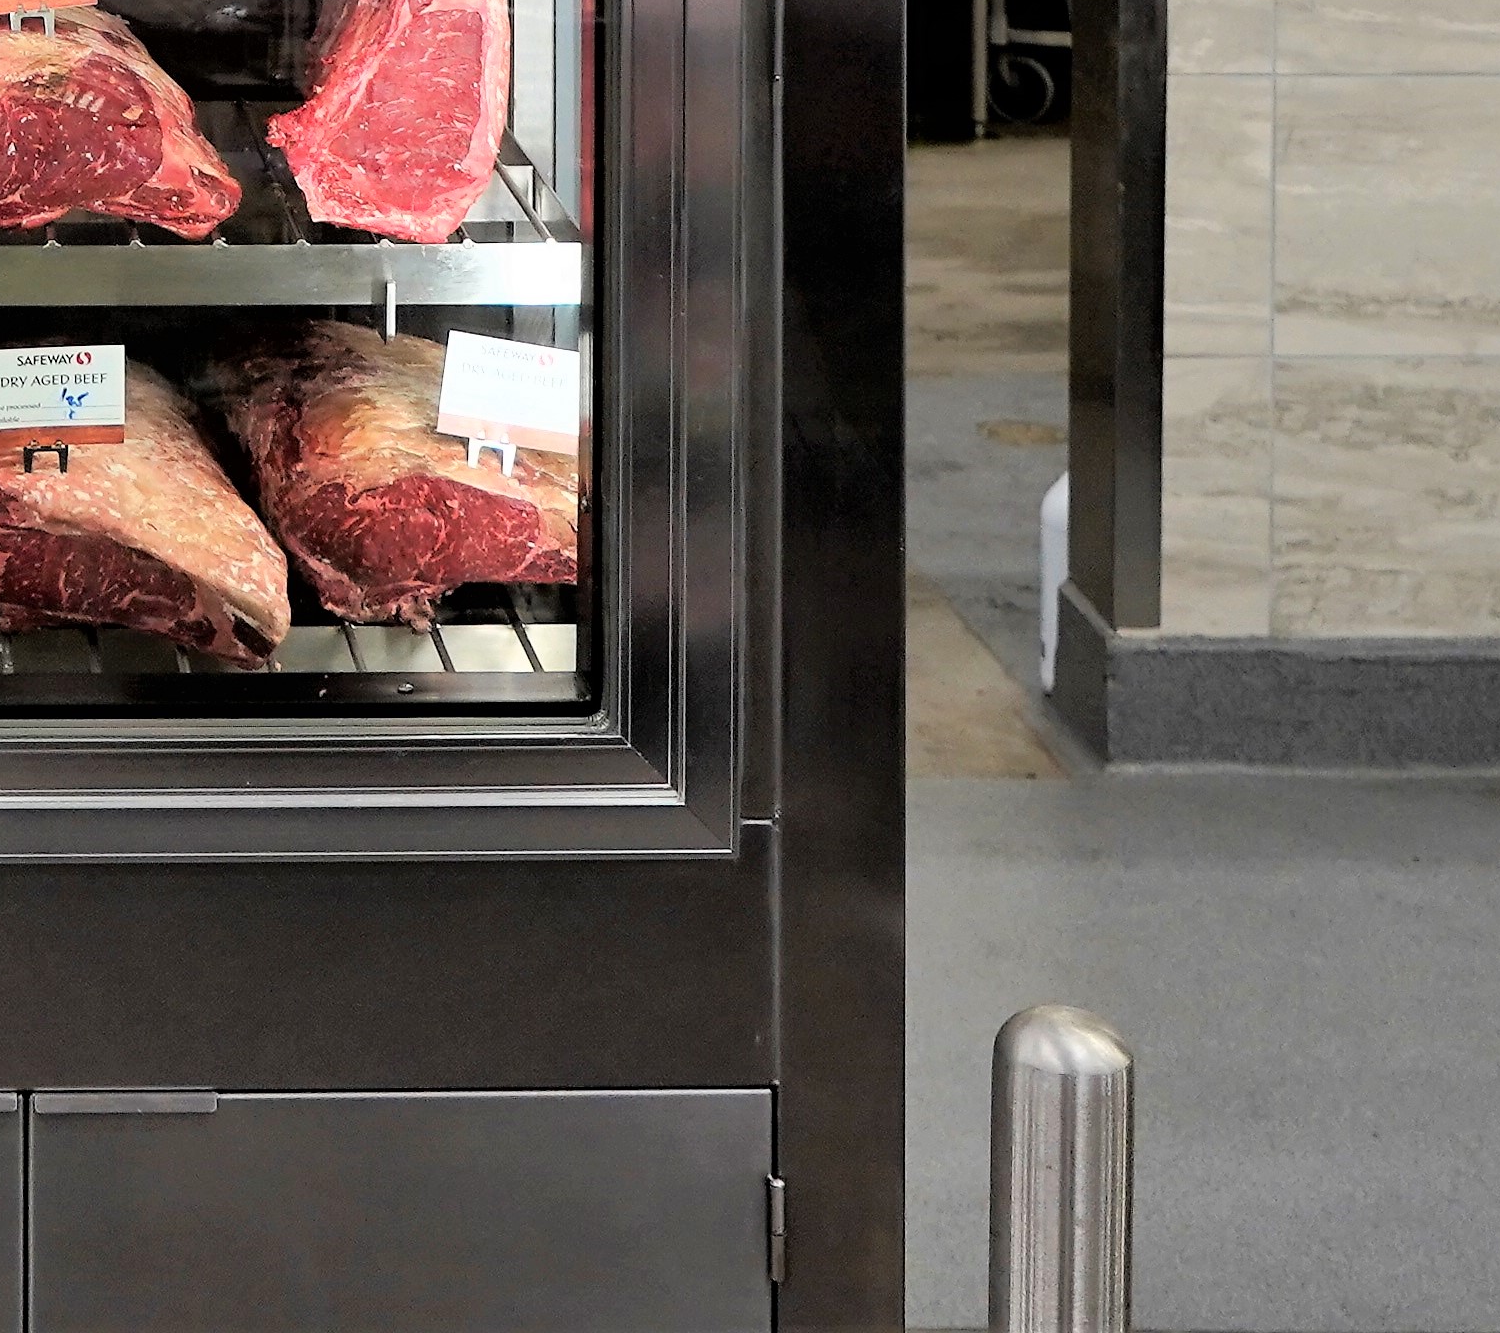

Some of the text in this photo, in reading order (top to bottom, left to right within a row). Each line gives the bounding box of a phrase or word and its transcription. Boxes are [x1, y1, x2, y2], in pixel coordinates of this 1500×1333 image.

[17, 352, 74, 368] SAFEWAY
[0, 372, 108, 389] DRY AGED BEEF
